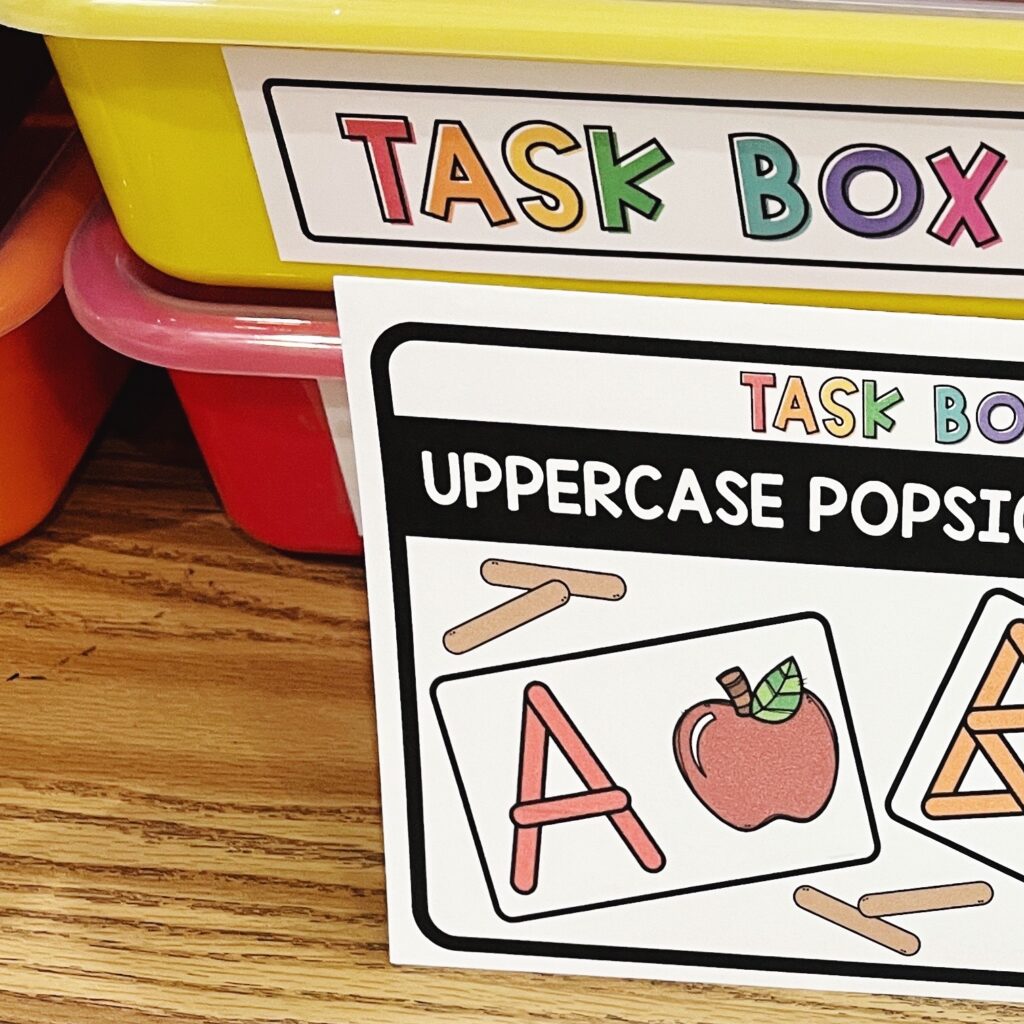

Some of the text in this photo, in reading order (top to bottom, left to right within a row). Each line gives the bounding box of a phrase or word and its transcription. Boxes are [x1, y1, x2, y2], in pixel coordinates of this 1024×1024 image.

[336, 112, 1008, 250] TASK BOX
[739, 370, 904, 442] TASK
[420, 450, 784, 530] UPPERCASE
